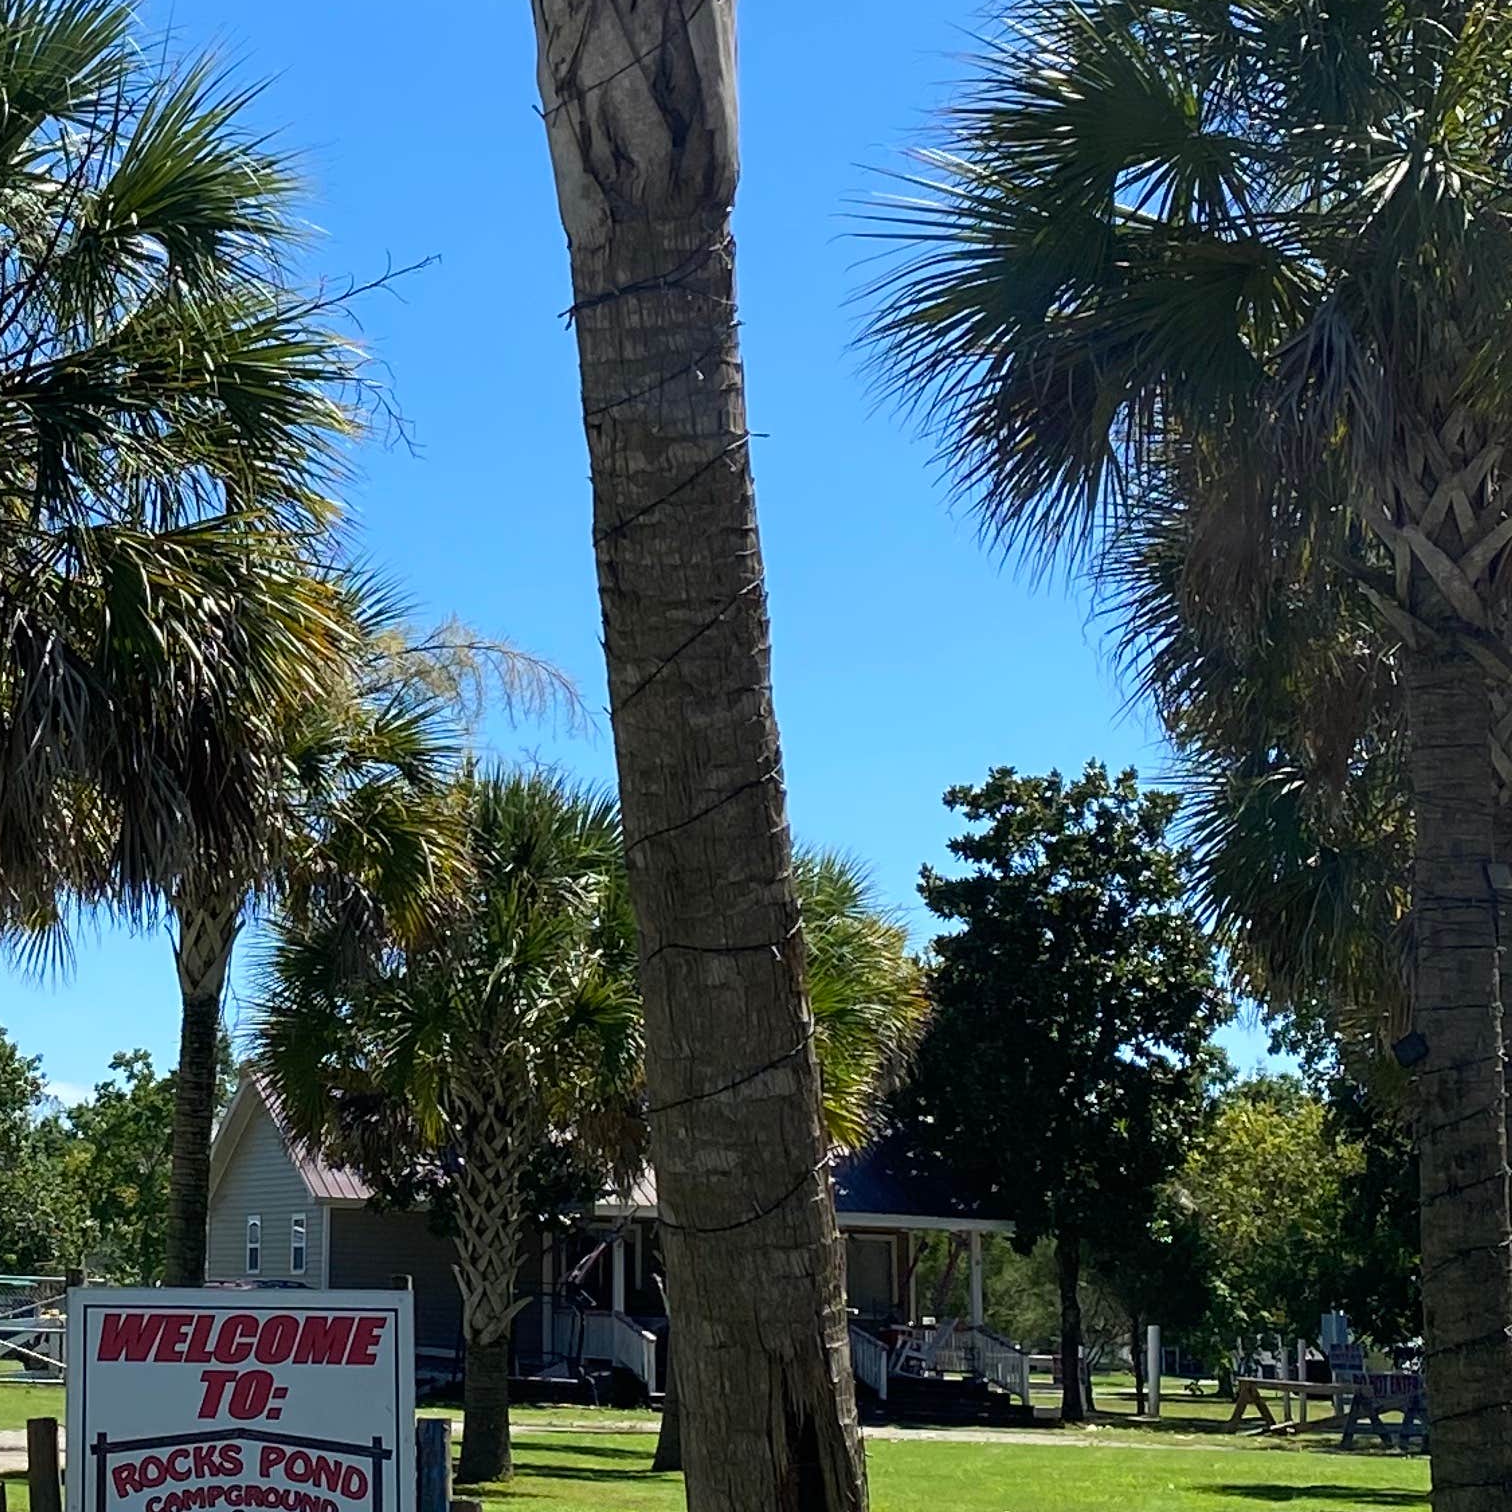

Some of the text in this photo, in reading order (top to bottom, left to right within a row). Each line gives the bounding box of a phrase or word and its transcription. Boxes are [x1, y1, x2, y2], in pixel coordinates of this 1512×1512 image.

[97, 1314, 387, 1365] WELCOME
[197, 1370, 288, 1420] TO:
[112, 1444, 369, 1500] ROCKS POND
[145, 1485, 340, 1512] CAMPGROUND
